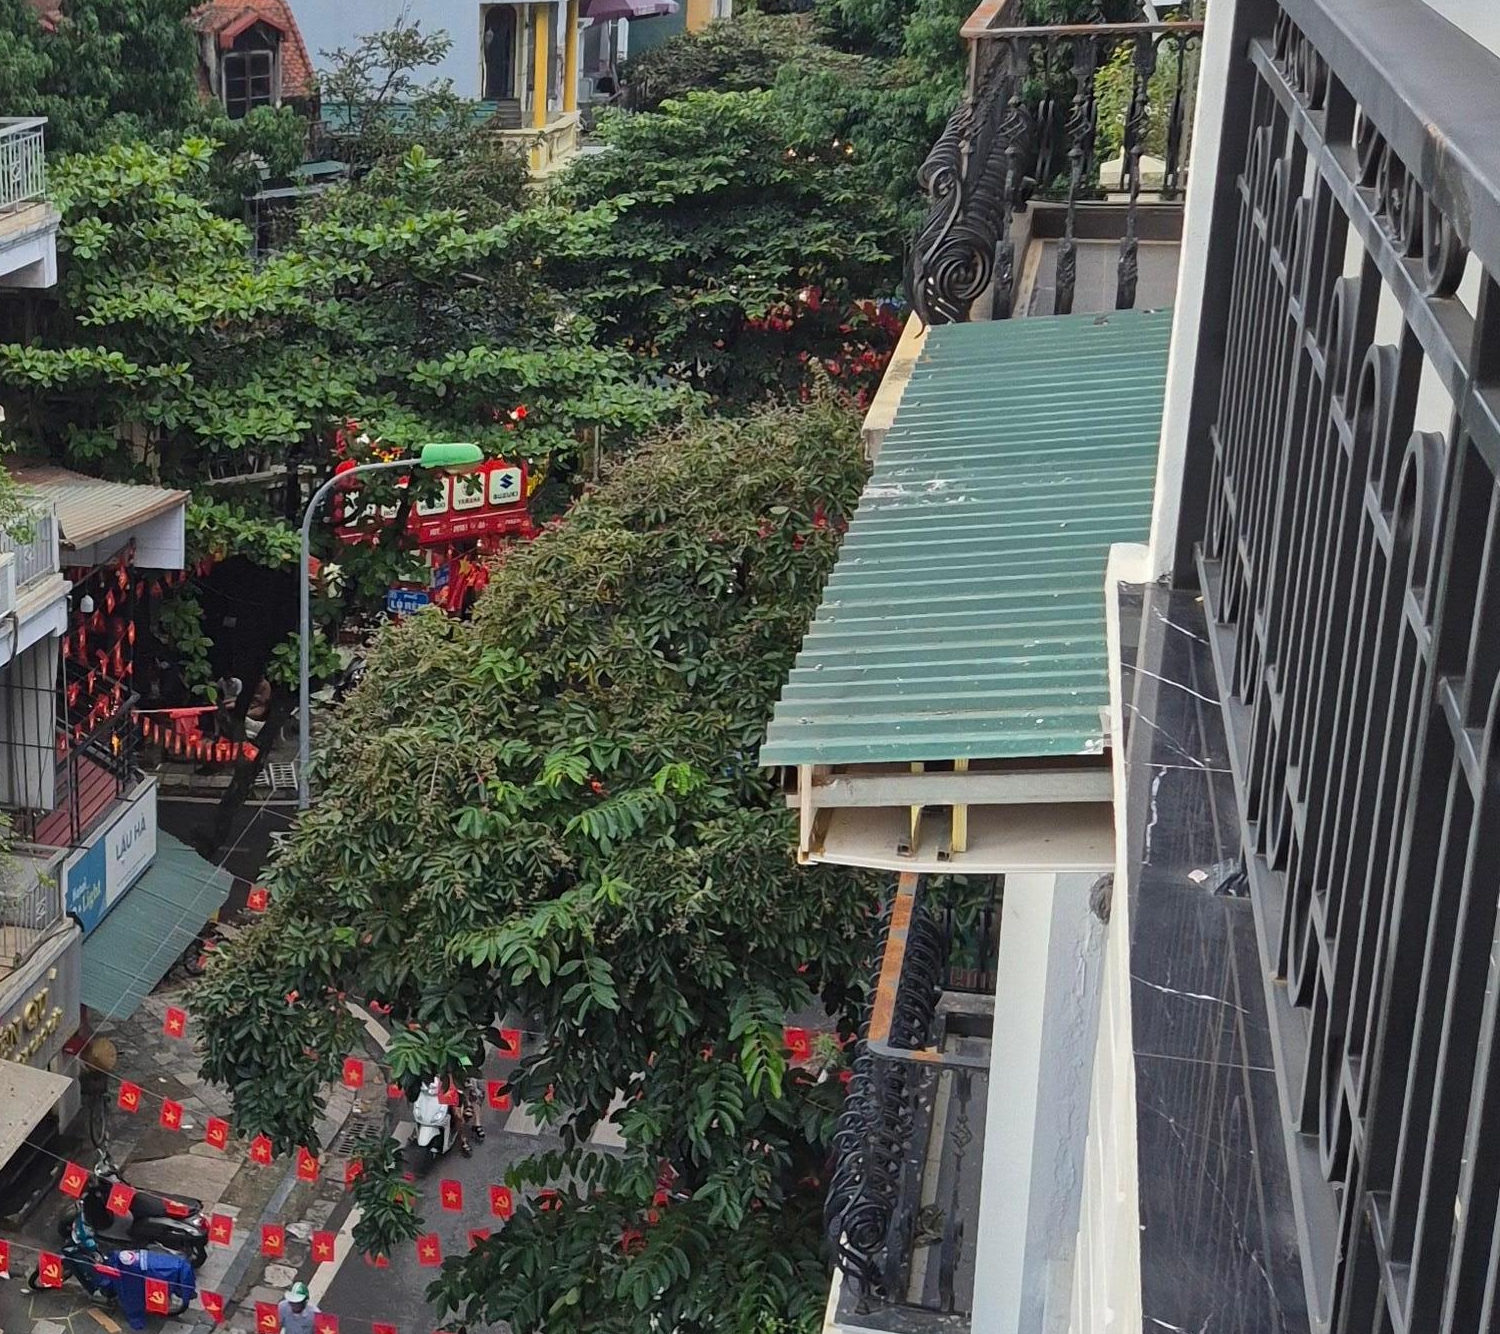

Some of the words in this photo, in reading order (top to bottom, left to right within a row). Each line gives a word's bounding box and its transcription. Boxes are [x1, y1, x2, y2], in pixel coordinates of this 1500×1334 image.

[493, 490, 519, 500] SUZUKI
[420, 501, 446, 511] PIGIO
[458, 496, 481, 506] YAMAHA
